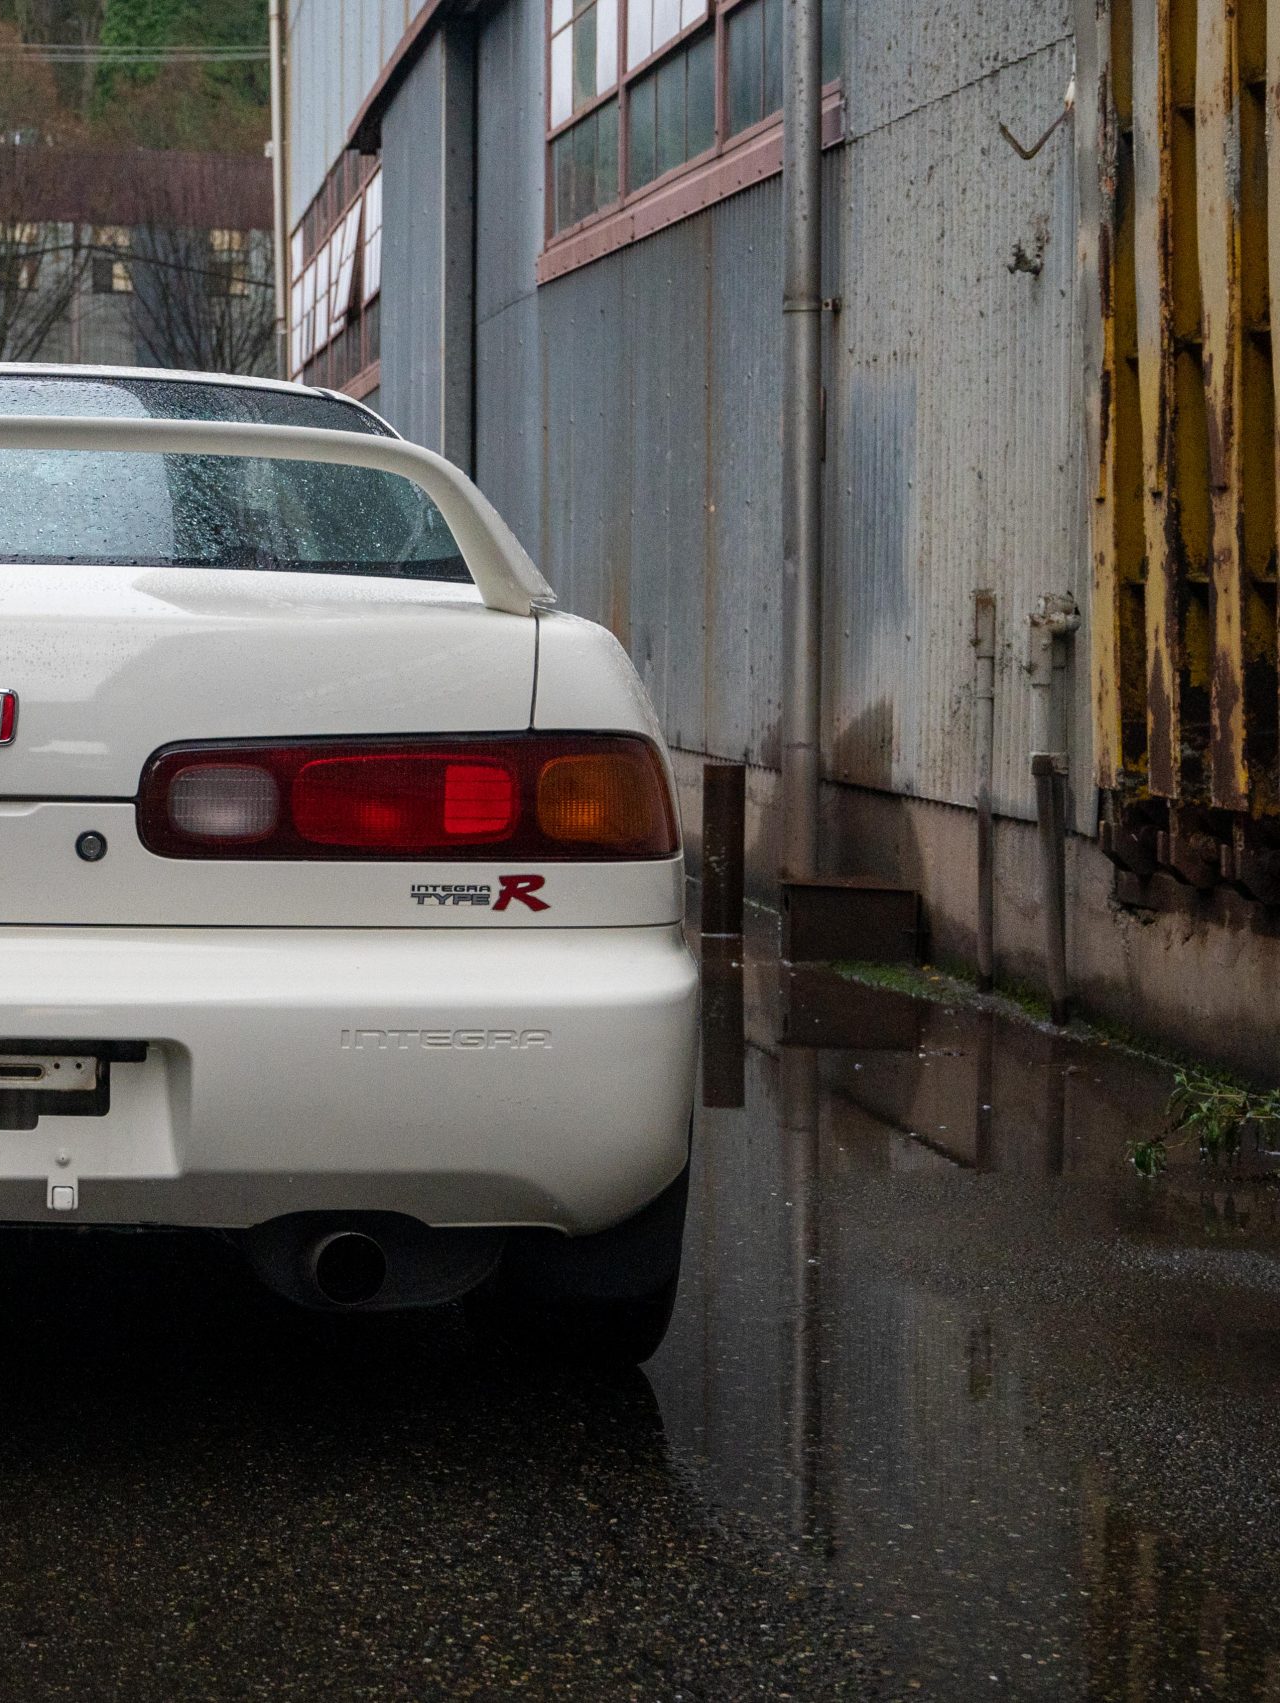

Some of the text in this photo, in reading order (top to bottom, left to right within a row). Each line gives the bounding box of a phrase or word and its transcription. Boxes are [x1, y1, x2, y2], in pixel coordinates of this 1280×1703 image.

[410, 874, 551, 912] TYPE R
[411, 884, 491, 893] INTEGRA
[340, 1029, 553, 1050] INTEGRA
